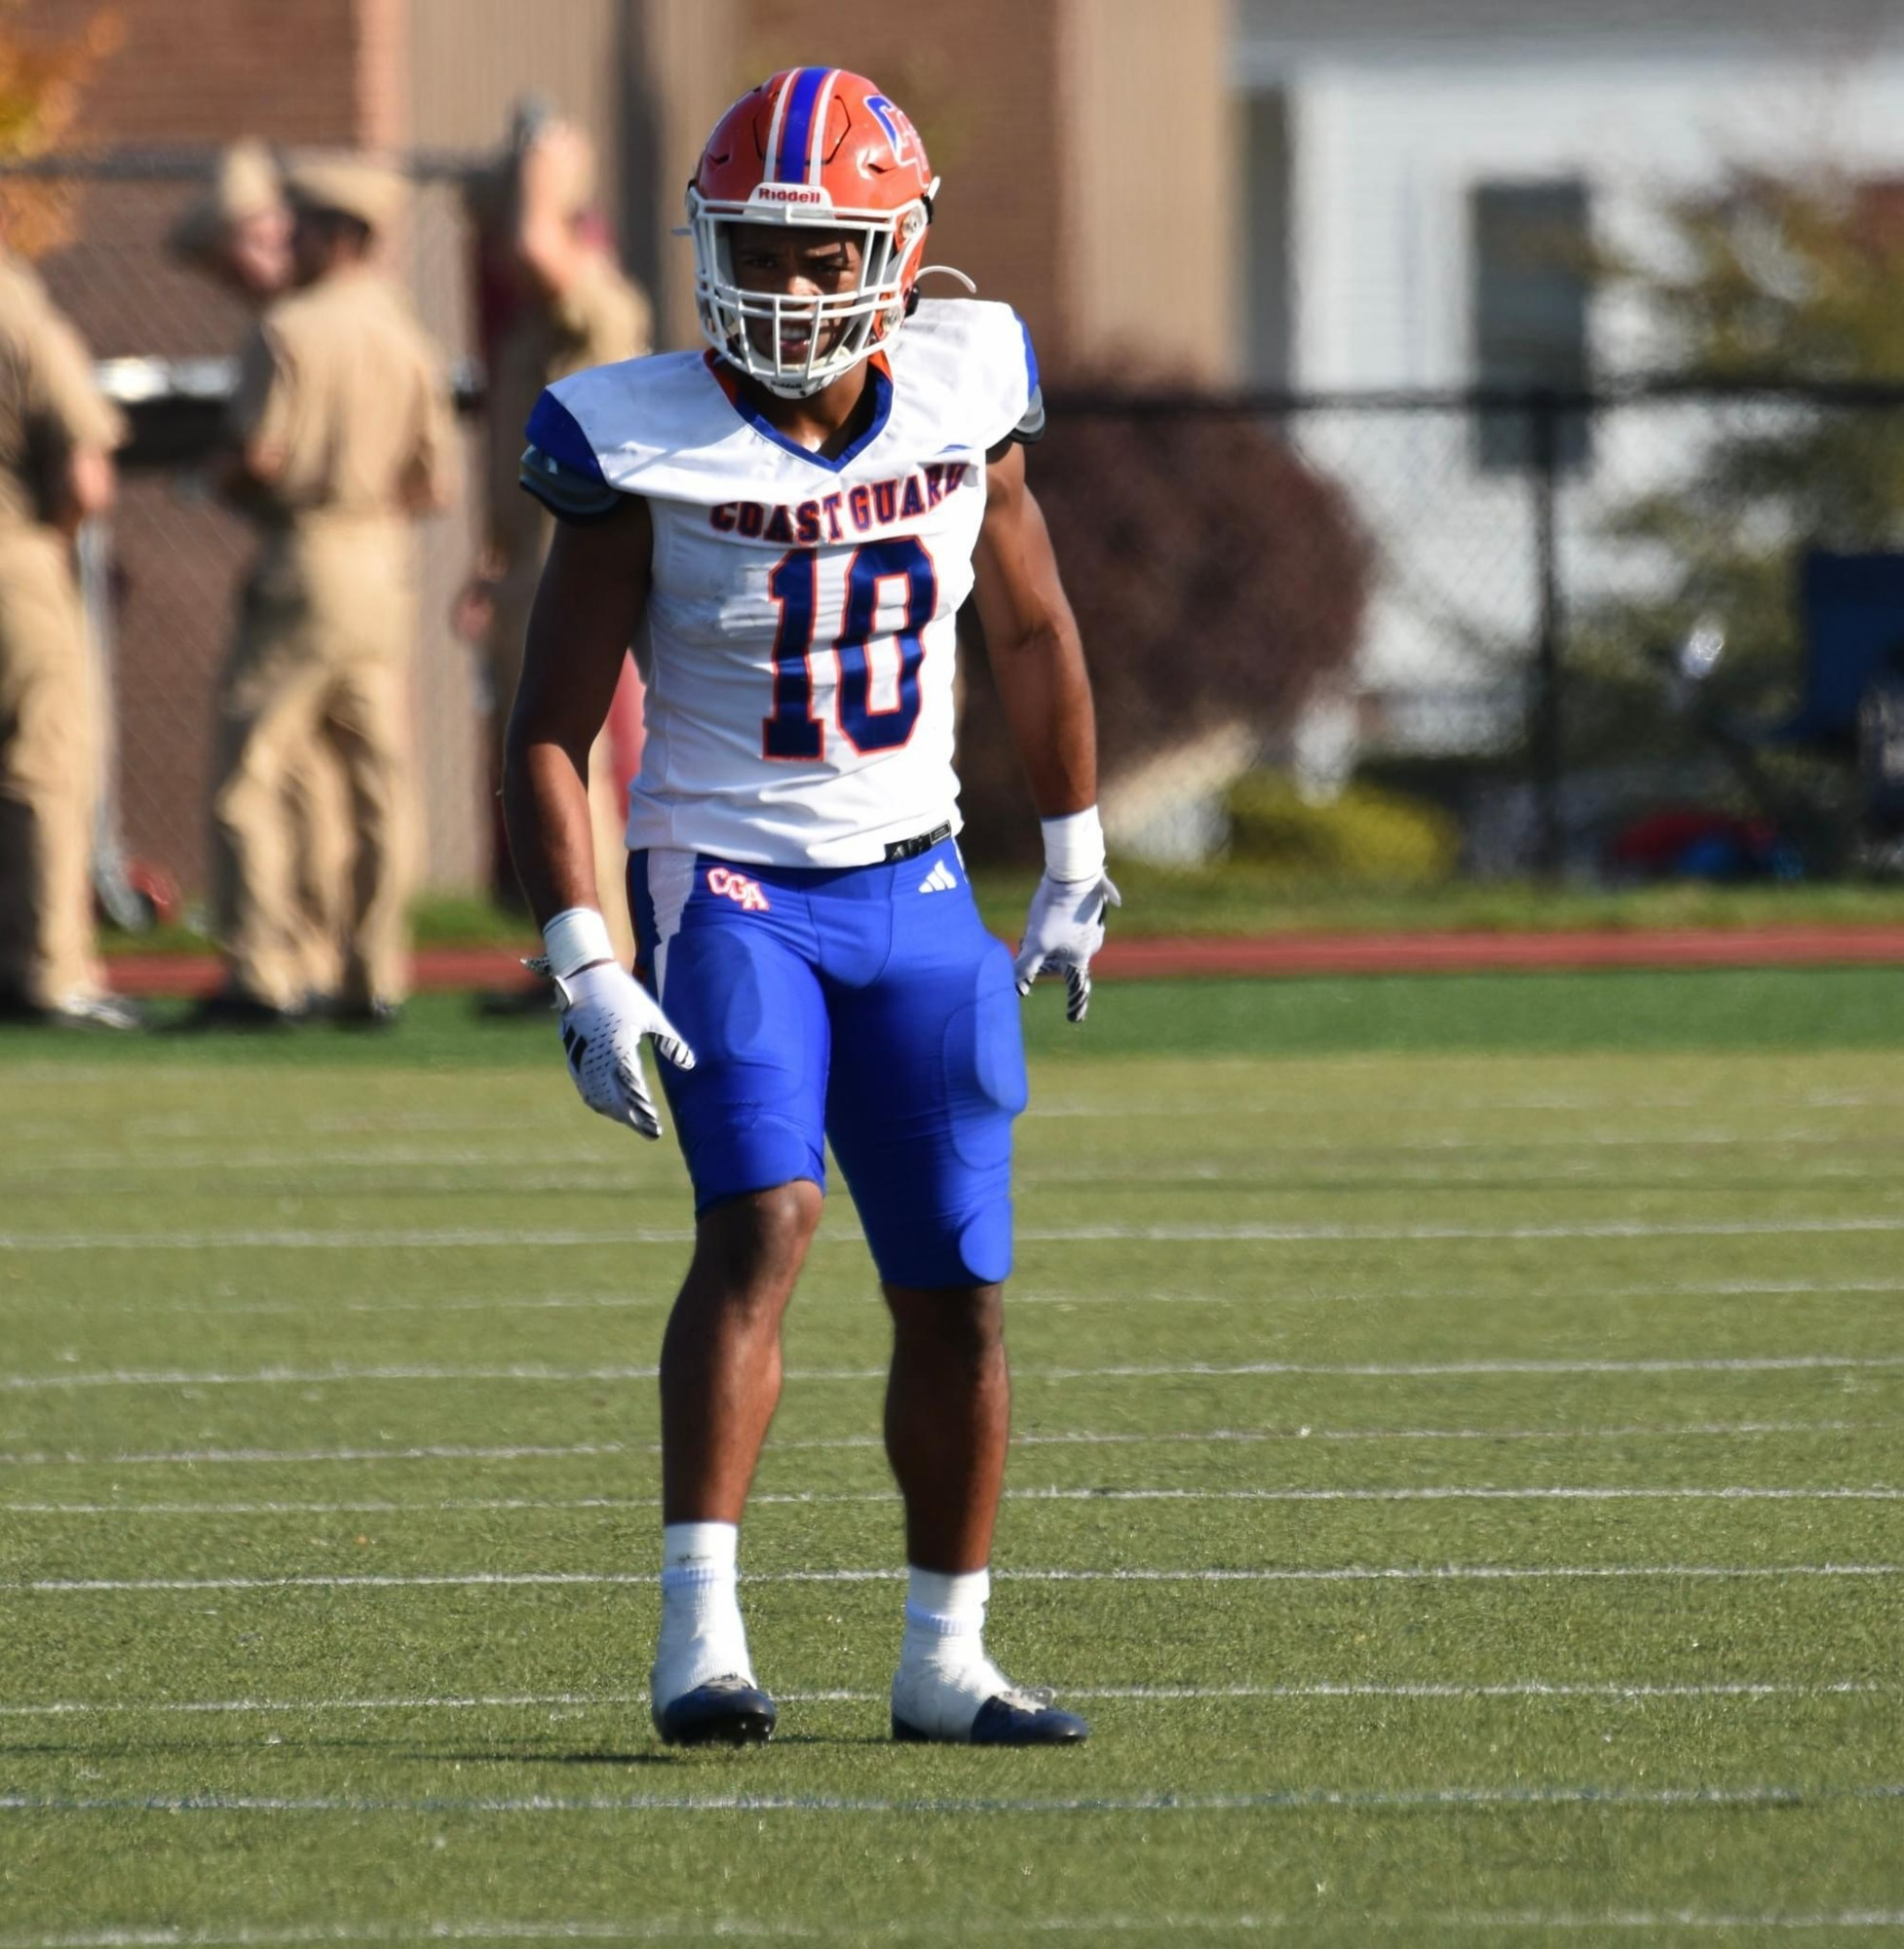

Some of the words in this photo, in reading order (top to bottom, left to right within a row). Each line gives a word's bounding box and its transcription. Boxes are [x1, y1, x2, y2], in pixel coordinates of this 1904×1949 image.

[758, 187, 820, 203] Riddell
[709, 492, 844, 544] COAST
[762, 534, 937, 761] 10
